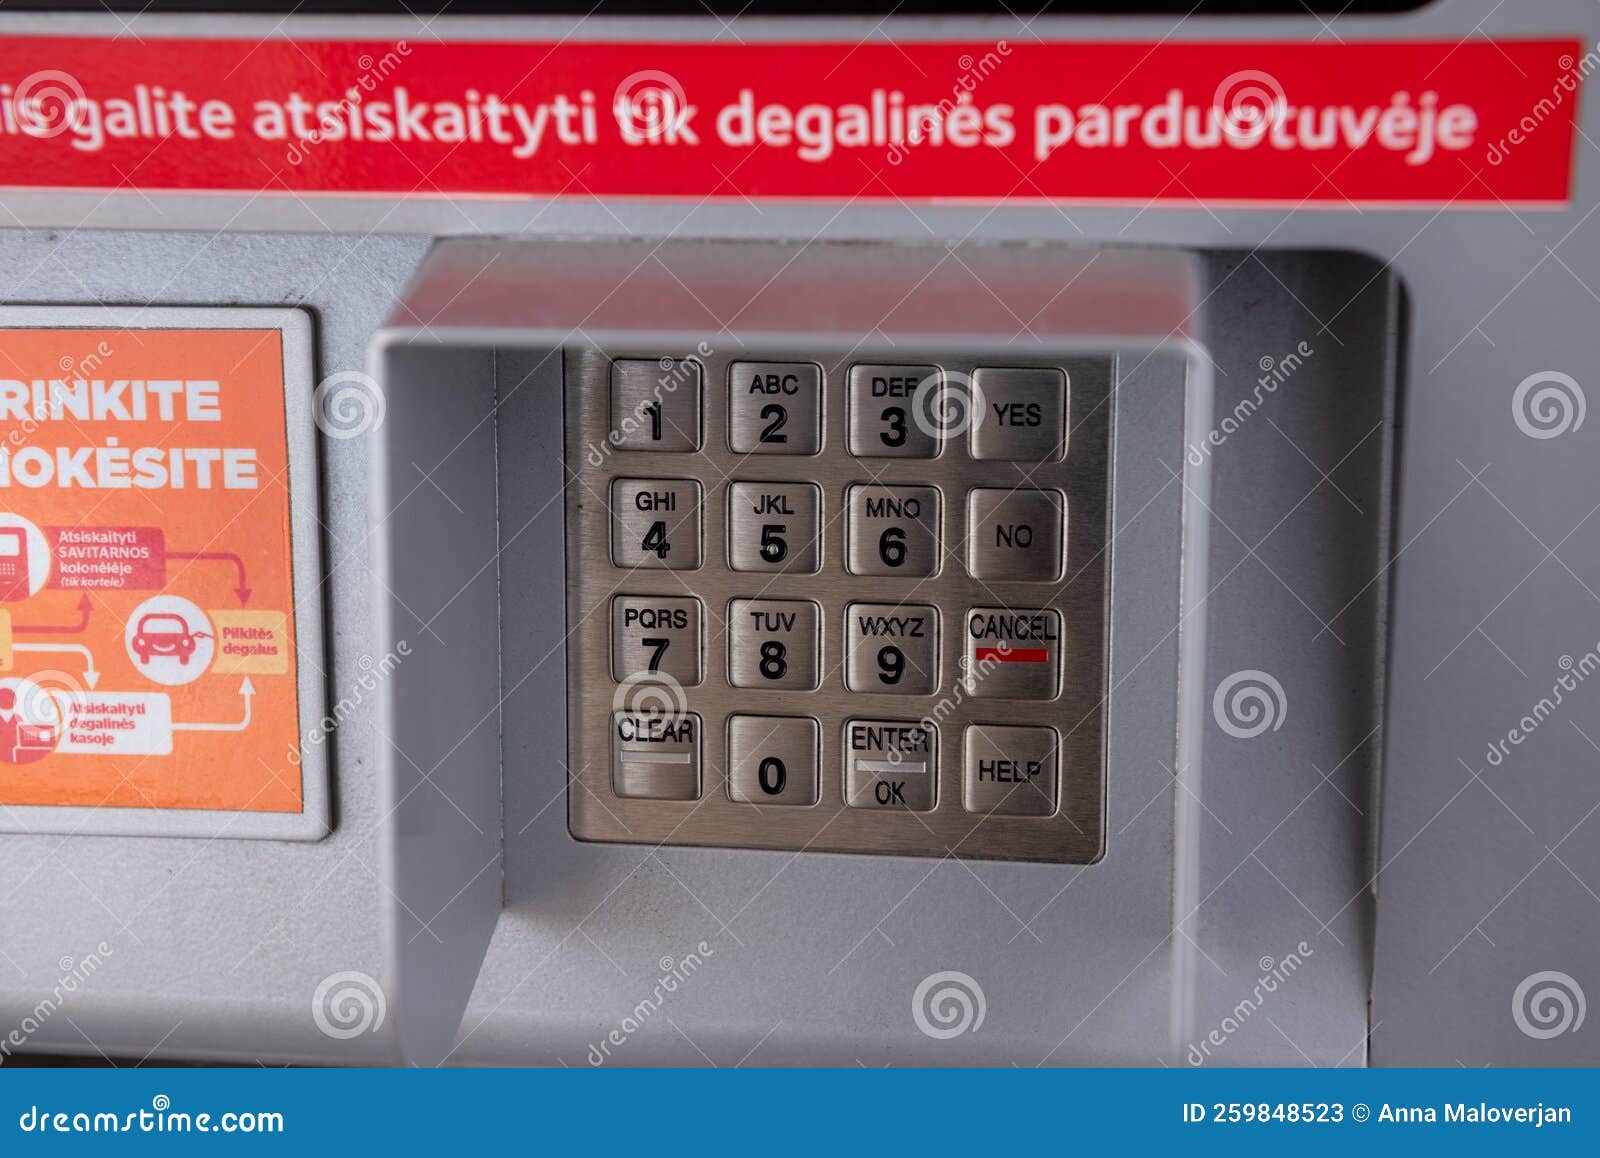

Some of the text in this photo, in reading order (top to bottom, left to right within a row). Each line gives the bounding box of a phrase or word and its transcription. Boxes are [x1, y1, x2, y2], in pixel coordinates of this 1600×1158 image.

[65, 84, 235, 151] galite
[253, 87, 596, 158] atsiskaityti
[613, 88, 700, 146] tik
[717, 89, 1016, 162] degalinės
[1035, 89, 1479, 165] parduotuvėje
[749, 374, 799, 396] ABC
[872, 376, 919, 398] DEF
[0, 379, 222, 421] RINKITE
[642, 401, 663, 441] 1
[759, 404, 788, 444] 2
[879, 406, 908, 448] 3
[992, 403, 1042, 427] YES
[634, 491, 676, 512] GHI
[753, 495, 795, 516] JKL
[866, 498, 921, 519] MNO
[59, 530, 137, 545] Atsiskaityti
[641, 521, 671, 559] 4
[759, 524, 788, 563] 5
[878, 526, 908, 567] 6
[996, 524, 1033, 549] NO
[59, 545, 150, 559] SAVITARNOS
[624, 608, 688, 630] PQRS
[750, 612, 797, 632] TUV
[859, 616, 925, 637] WXYZ
[969, 614, 1057, 641] CANCEL
[223, 642, 278, 656] degalus
[641, 638, 670, 675] 7
[759, 640, 788, 680] 8
[876, 645, 906, 684] 9
[70, 733, 115, 746] kasoje
[617, 717, 694, 744] CLEAR
[851, 727, 929, 751] ENTER
[758, 756, 787, 796] 0
[978, 760, 1042, 783] HELP
[874, 780, 906, 805] OK
